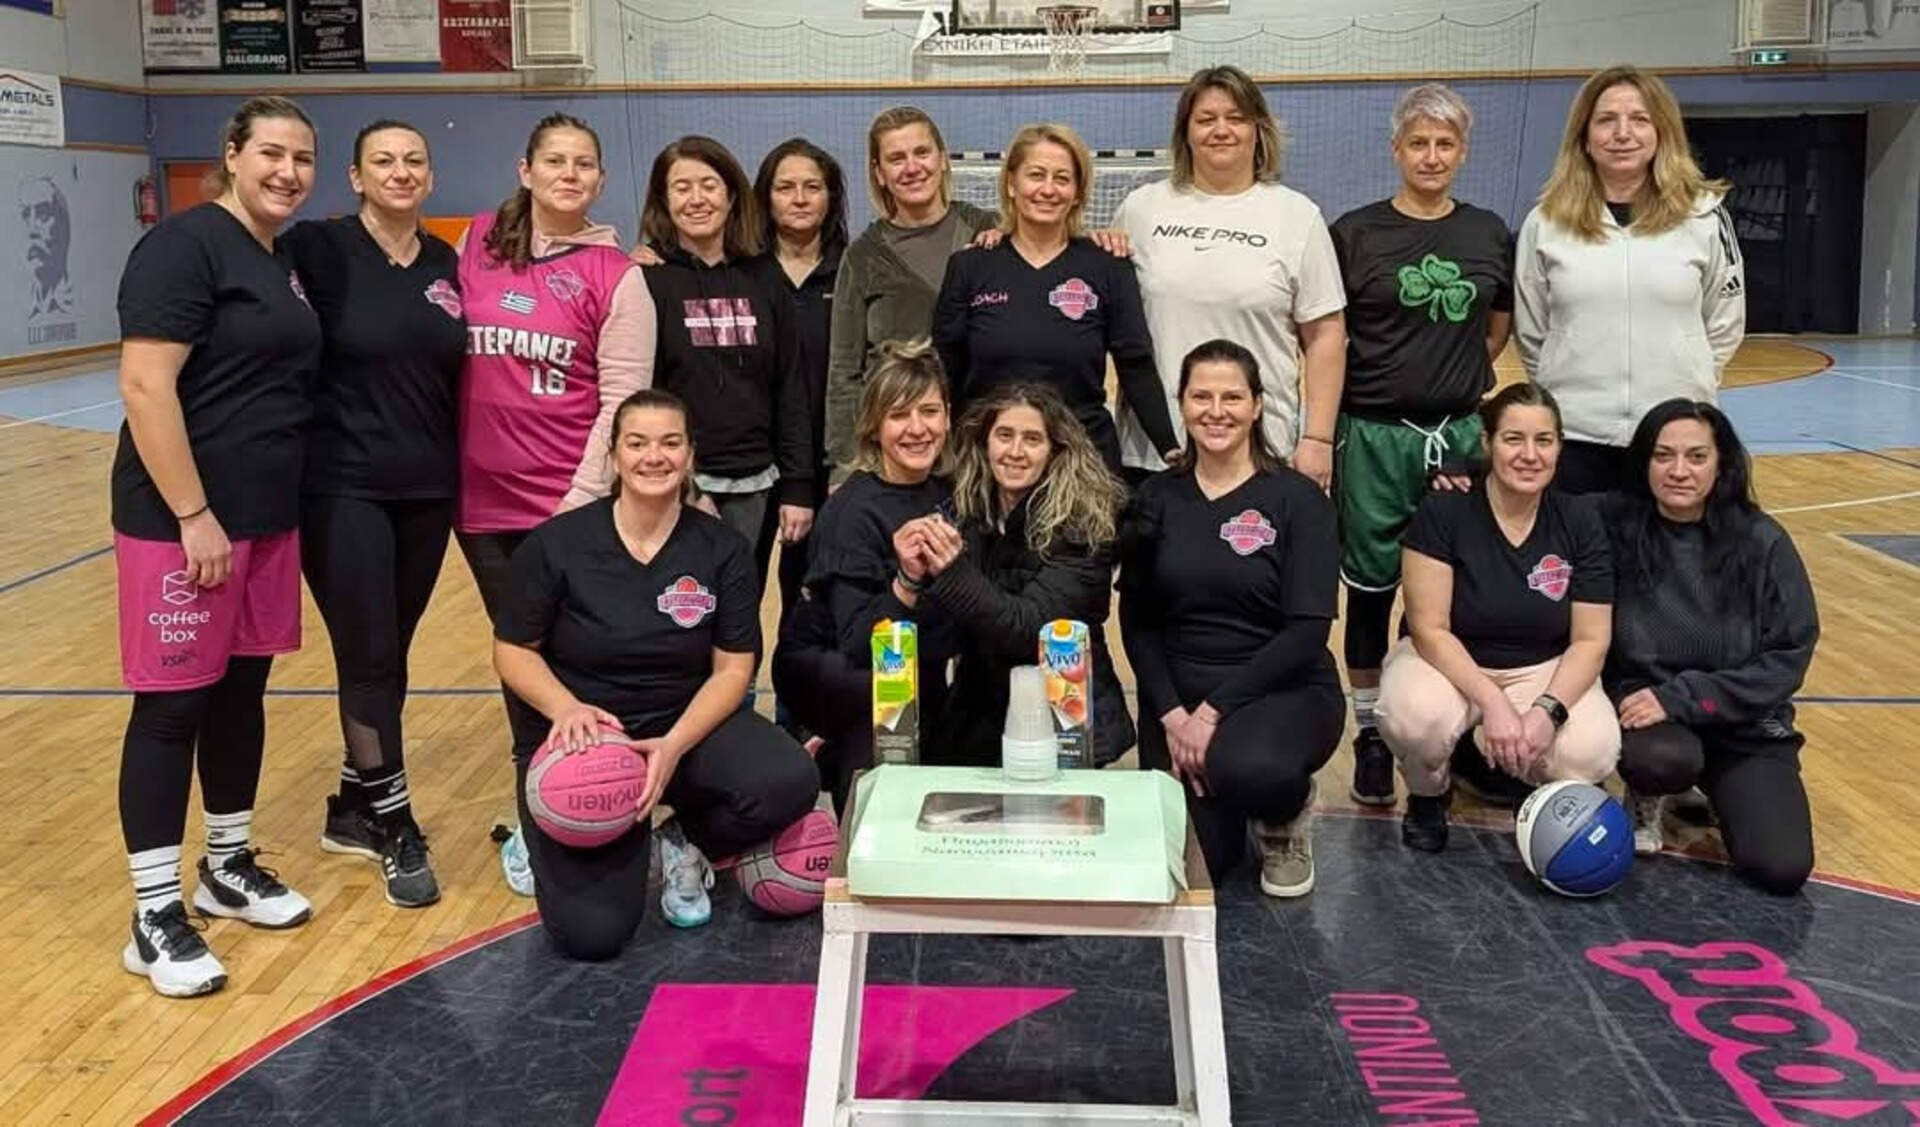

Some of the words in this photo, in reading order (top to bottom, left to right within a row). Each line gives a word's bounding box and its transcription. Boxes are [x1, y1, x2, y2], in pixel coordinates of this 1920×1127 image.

[920, 38, 993, 52] ΕΧΝΙΚΗ
[0, 89, 55, 107] METALS
[1152, 224, 1210, 240] NIKE
[1210, 229, 1267, 248] PRO
[530, 364, 568, 396] 16
[148, 610, 211, 626] coffee
[160, 626, 198, 643] box
[568, 783, 643, 812] molten
[680, 1068, 749, 1127] ort
